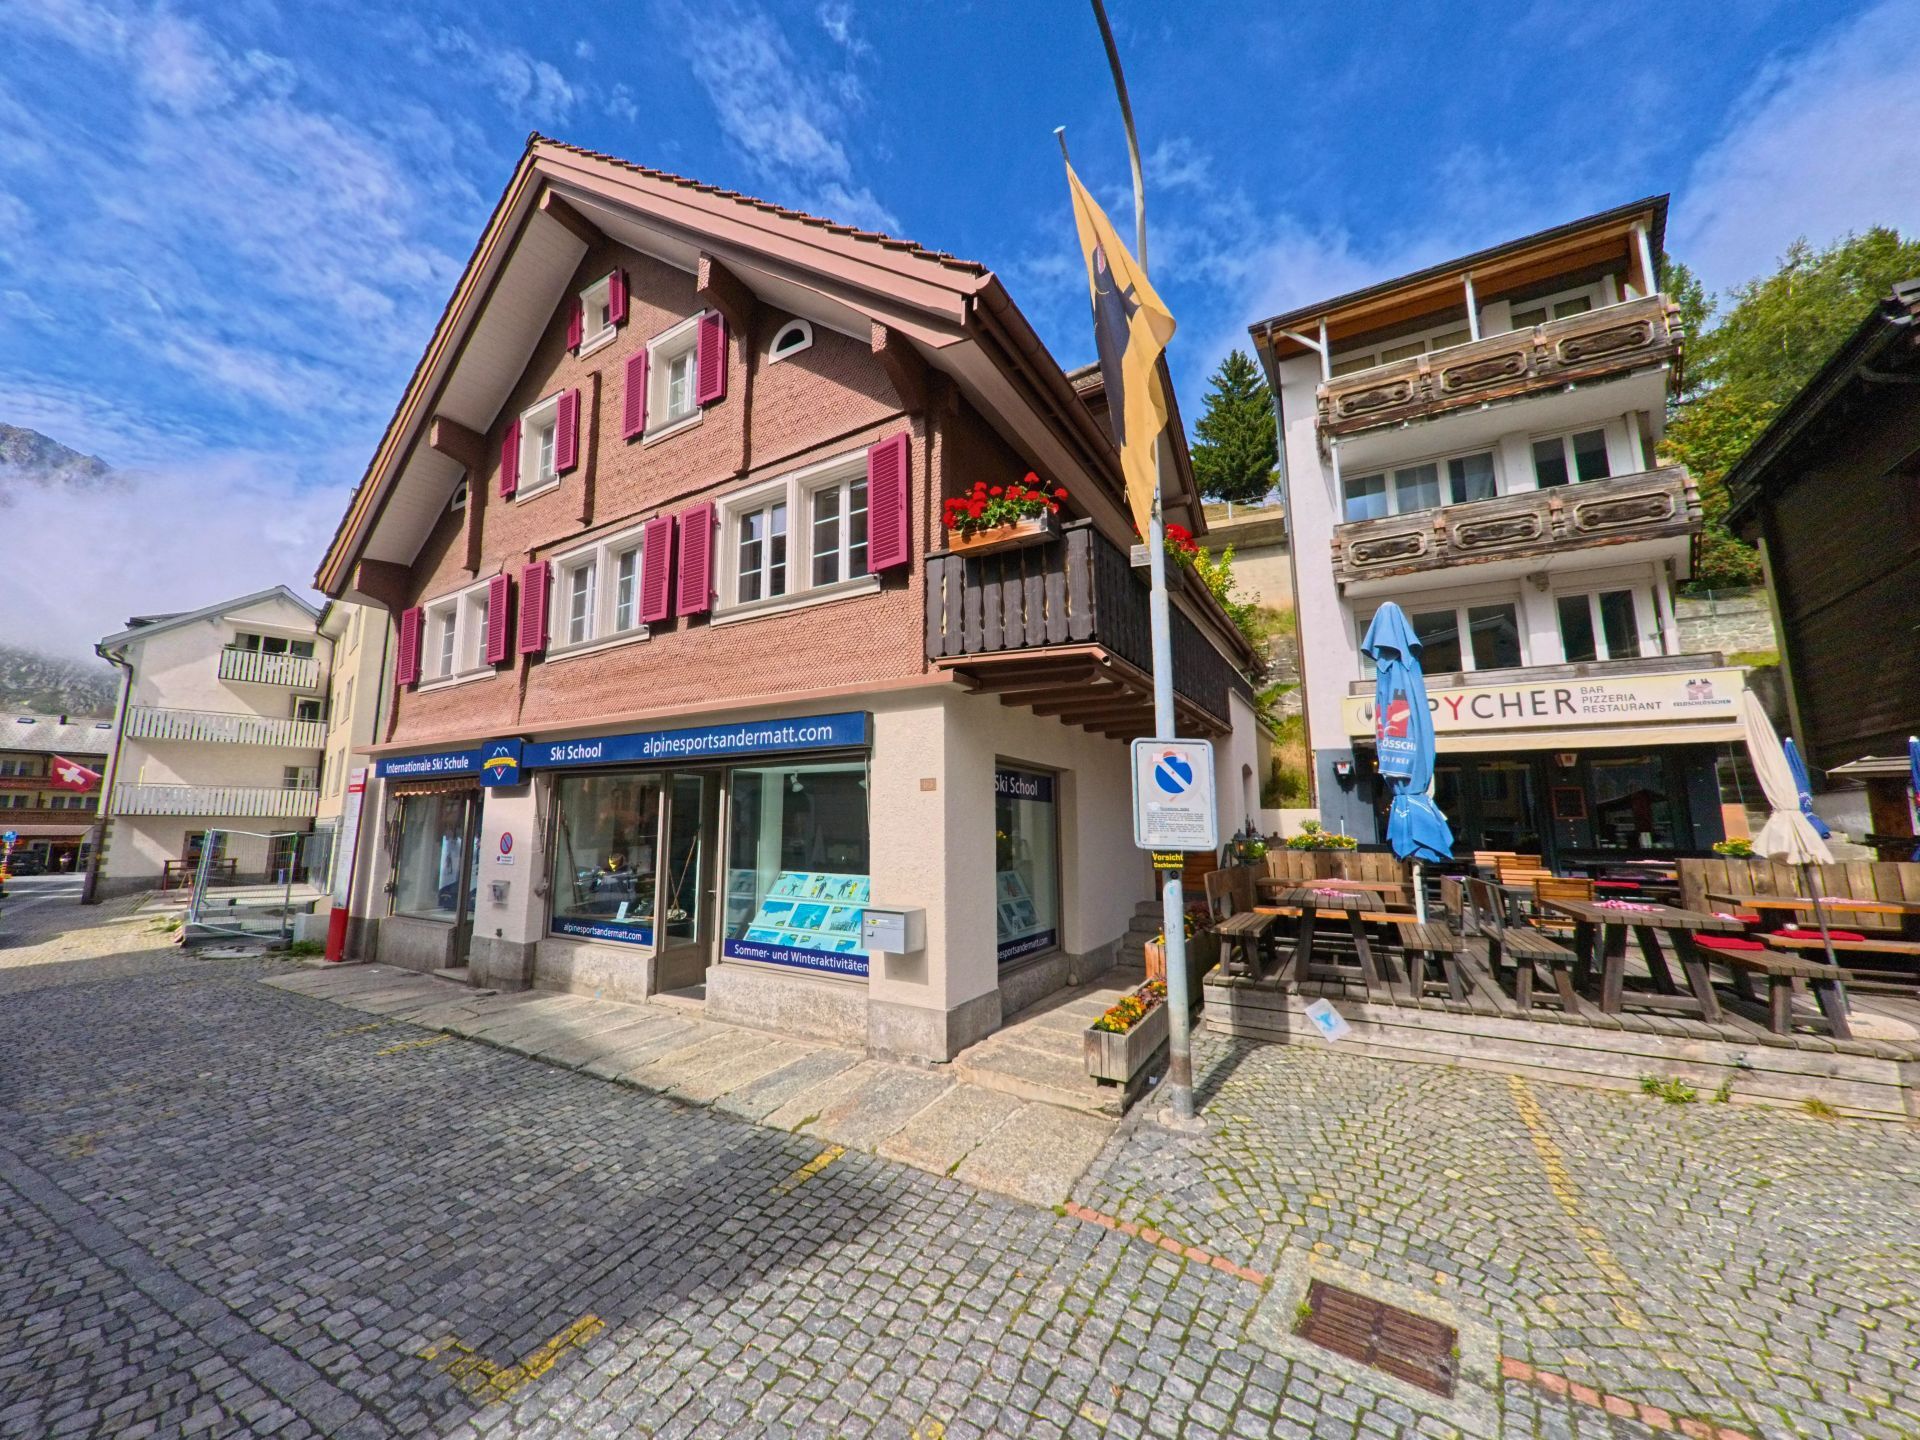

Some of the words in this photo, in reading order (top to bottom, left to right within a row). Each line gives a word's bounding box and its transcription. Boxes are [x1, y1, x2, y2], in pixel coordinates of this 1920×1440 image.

[1580, 685, 1605, 695] BAR
[1582, 693, 1637, 704] PIZZERIA
[1427, 688, 1578, 721] PYCHER
[1583, 701, 1662, 714] RESTAURANT
[643, 726, 832, 757] alpinesportsandermatt.com
[550, 745, 565, 761] Ski
[567, 742, 602, 760] School
[386, 757, 431, 774] Internationale
[432, 757, 443, 771] Ski
[444, 755, 469, 770] Schule
[994, 774, 1008, 793] Ski
[1010, 776, 1038, 796] School
[1152, 852, 1184, 862] Vorsicht
[563, 922, 642, 942] alpinesportsandermatt.com
[734, 943, 770, 959] Sommer-
[772, 949, 789, 961] und
[790, 951, 869, 973] Winteraktivitäten
